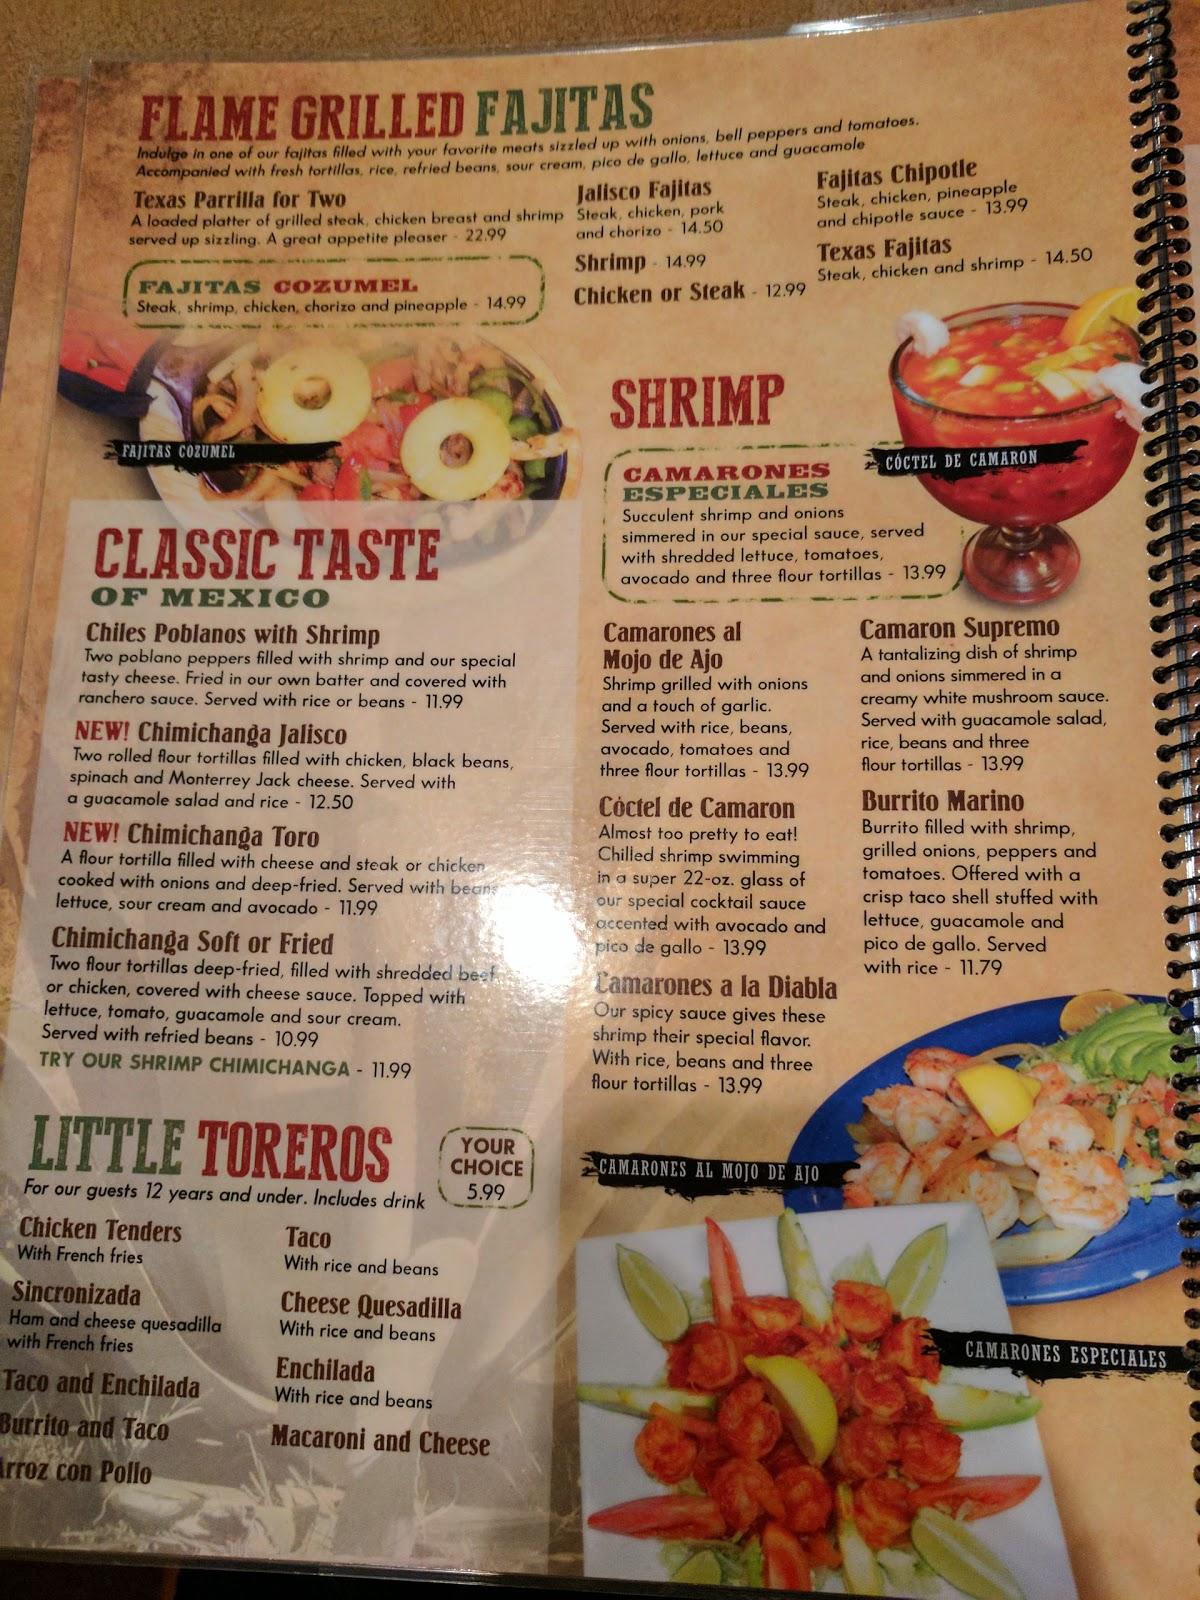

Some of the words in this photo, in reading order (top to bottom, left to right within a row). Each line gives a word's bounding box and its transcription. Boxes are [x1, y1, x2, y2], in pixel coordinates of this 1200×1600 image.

[138, 94, 279, 142] FLAME
[290, 91, 464, 140] GRILLED
[475, 82, 654, 136] FAJITAS
[817, 168, 883, 192] Fajitas
[890, 158, 977, 185] Chipotle
[133, 190, 186, 209] Texas
[194, 190, 265, 208] Parrilla
[272, 190, 300, 208] for
[307, 189, 346, 207] Two
[577, 182, 640, 205] Jalisco
[648, 178, 712, 201] Fajitas
[937, 178, 1017, 203] pineapple
[130, 213, 142, 226] A
[147, 213, 198, 227] loaded
[202, 213, 251, 229] platter
[255, 212, 270, 226] of
[275, 212, 322, 229] grilled
[374, 211, 426, 225] chicken
[431, 210, 477, 224] breast
[482, 208, 511, 223] and
[516, 208, 564, 223] shrimp
[690, 200, 724, 218] pork
[816, 242, 876, 261] Texas
[884, 236, 952, 260] Fajitas
[574, 252, 646, 274] Shrimp
[666, 253, 706, 268] 14.99
[138, 280, 261, 294] FAJITAS
[273, 278, 418, 294] COZUMEL
[574, 285, 652, 305] Chicken
[660, 287, 682, 302] or
[690, 279, 745, 300] Steak
[766, 281, 806, 297] 12.99
[304, 298, 356, 313] chorizo
[360, 297, 389, 312] and
[394, 296, 468, 314] pineapple
[487, 295, 526, 309] 14.99
[610, 373, 785, 429] SHRIMP
[121, 444, 172, 460] FAJITAS
[178, 444, 235, 458] COZUMEL
[944, 453, 961, 467] DE
[969, 449, 1037, 466] CAMARON
[623, 462, 830, 482] CAMARONES
[622, 482, 829, 502] ESPECIALES
[622, 507, 694, 522] Succulent
[700, 506, 752, 524] shrimp
[758, 504, 788, 519] and
[794, 506, 844, 519] onions
[94, 527, 280, 580] CLASSIC
[292, 528, 440, 580] TASTE
[620, 569, 690, 584] avocado
[695, 568, 726, 583] and
[732, 568, 772, 583] three
[778, 568, 813, 582] flour
[819, 565, 882, 581] tortillas
[903, 564, 946, 579] 13.99
[90, 586, 148, 606] OF
[160, 587, 330, 608] MEXICO
[86, 621, 146, 642] Chiles
[153, 623, 246, 643] Poblanos
[254, 623, 297, 644] with
[305, 624, 380, 649] Shrimp
[603, 622, 716, 642] Camarones
[722, 620, 741, 641] al
[860, 618, 956, 640] Camaron
[963, 616, 1060, 642] Supremo
[603, 648, 652, 673] Mojo
[659, 648, 683, 669] de
[690, 648, 723, 673] Ajo
[860, 695, 918, 708] creamy
[922, 688, 967, 704] white
[972, 687, 1053, 703] mushroom
[1058, 691, 1109, 703] sauce.
[74, 720, 130, 741] NEW!
[138, 721, 271, 748] Chimichanga
[277, 723, 347, 747] Jalisco
[69, 768, 128, 786] spinach
[133, 769, 164, 784] and
[168, 769, 251, 789] Monterrey
[255, 771, 290, 786] Jack
[297, 771, 354, 787] cheese.
[360, 773, 415, 788] Served
[420, 773, 456, 789] with
[668, 796, 693, 817] de
[700, 796, 795, 818] Camaron
[861, 789, 939, 811] Burrito
[947, 788, 1024, 811] Marino
[63, 821, 119, 842] NEW!
[127, 822, 263, 851] Chimichanga
[271, 825, 319, 847] Toro
[862, 889, 903, 908] crisp
[908, 890, 946, 903] taco
[951, 887, 988, 904] shell
[995, 888, 1053, 904] stuffed
[1059, 888, 1098, 904] with
[51, 925, 189, 955] Chimichanga
[197, 929, 240, 952] Soft
[248, 935, 272, 953] or
[279, 931, 334, 955] Fried
[720, 978, 733, 996] a
[740, 974, 760, 997] la
[768, 974, 838, 999] Diabla
[39, 1050, 75, 1067] TRY
[82, 1052, 122, 1068] OUR
[129, 1054, 203, 1071] SHRIMP
[209, 1056, 350, 1076] CHIMICHANGA
[372, 1061, 412, 1078] 11.99
[27, 1114, 185, 1175] LITTLE
[197, 1119, 392, 1182] TOREROS
[460, 1137, 515, 1154] YOUR
[450, 1158, 523, 1176] CHOICE
[598, 1157, 686, 1177] CAMARONES
[695, 1161, 713, 1177] AL
[722, 1162, 758, 1182] MOJO
[768, 1163, 785, 1180] DE
[794, 1164, 819, 1184] AJO
[466, 1183, 505, 1200] 5.99
[19, 1216, 97, 1239] Chicken
[105, 1218, 182, 1242] Tenders
[285, 1226, 331, 1248] Taco
[17, 1244, 51, 1260] With
[56, 1245, 104, 1262] French
[110, 1246, 143, 1263] fries
[284, 1254, 318, 1271] With
[324, 1258, 352, 1272] rice
[357, 1258, 387, 1274] and
[392, 1258, 439, 1276] beans
[10, 1280, 141, 1306] Sincronizada
[280, 1290, 350, 1314] Cheese
[357, 1294, 462, 1319] Quesadilla
[965, 1340, 1060, 1362] CAMARONES
[1070, 1345, 1166, 1368] ESPECIALES
[276, 1356, 375, 1382] Enchilada
[2, 1368, 49, 1392] Taco
[56, 1371, 95, 1394] and
[100, 1372, 200, 1398] Enchilada
[0, 1411, 70, 1437] Burrito
[76, 1415, 116, 1439] and
[122, 1416, 170, 1442] Taco
[270, 1423, 365, 1450] Macaroni
[373, 1429, 411, 1452] and
[419, 1431, 490, 1456] Cheese
